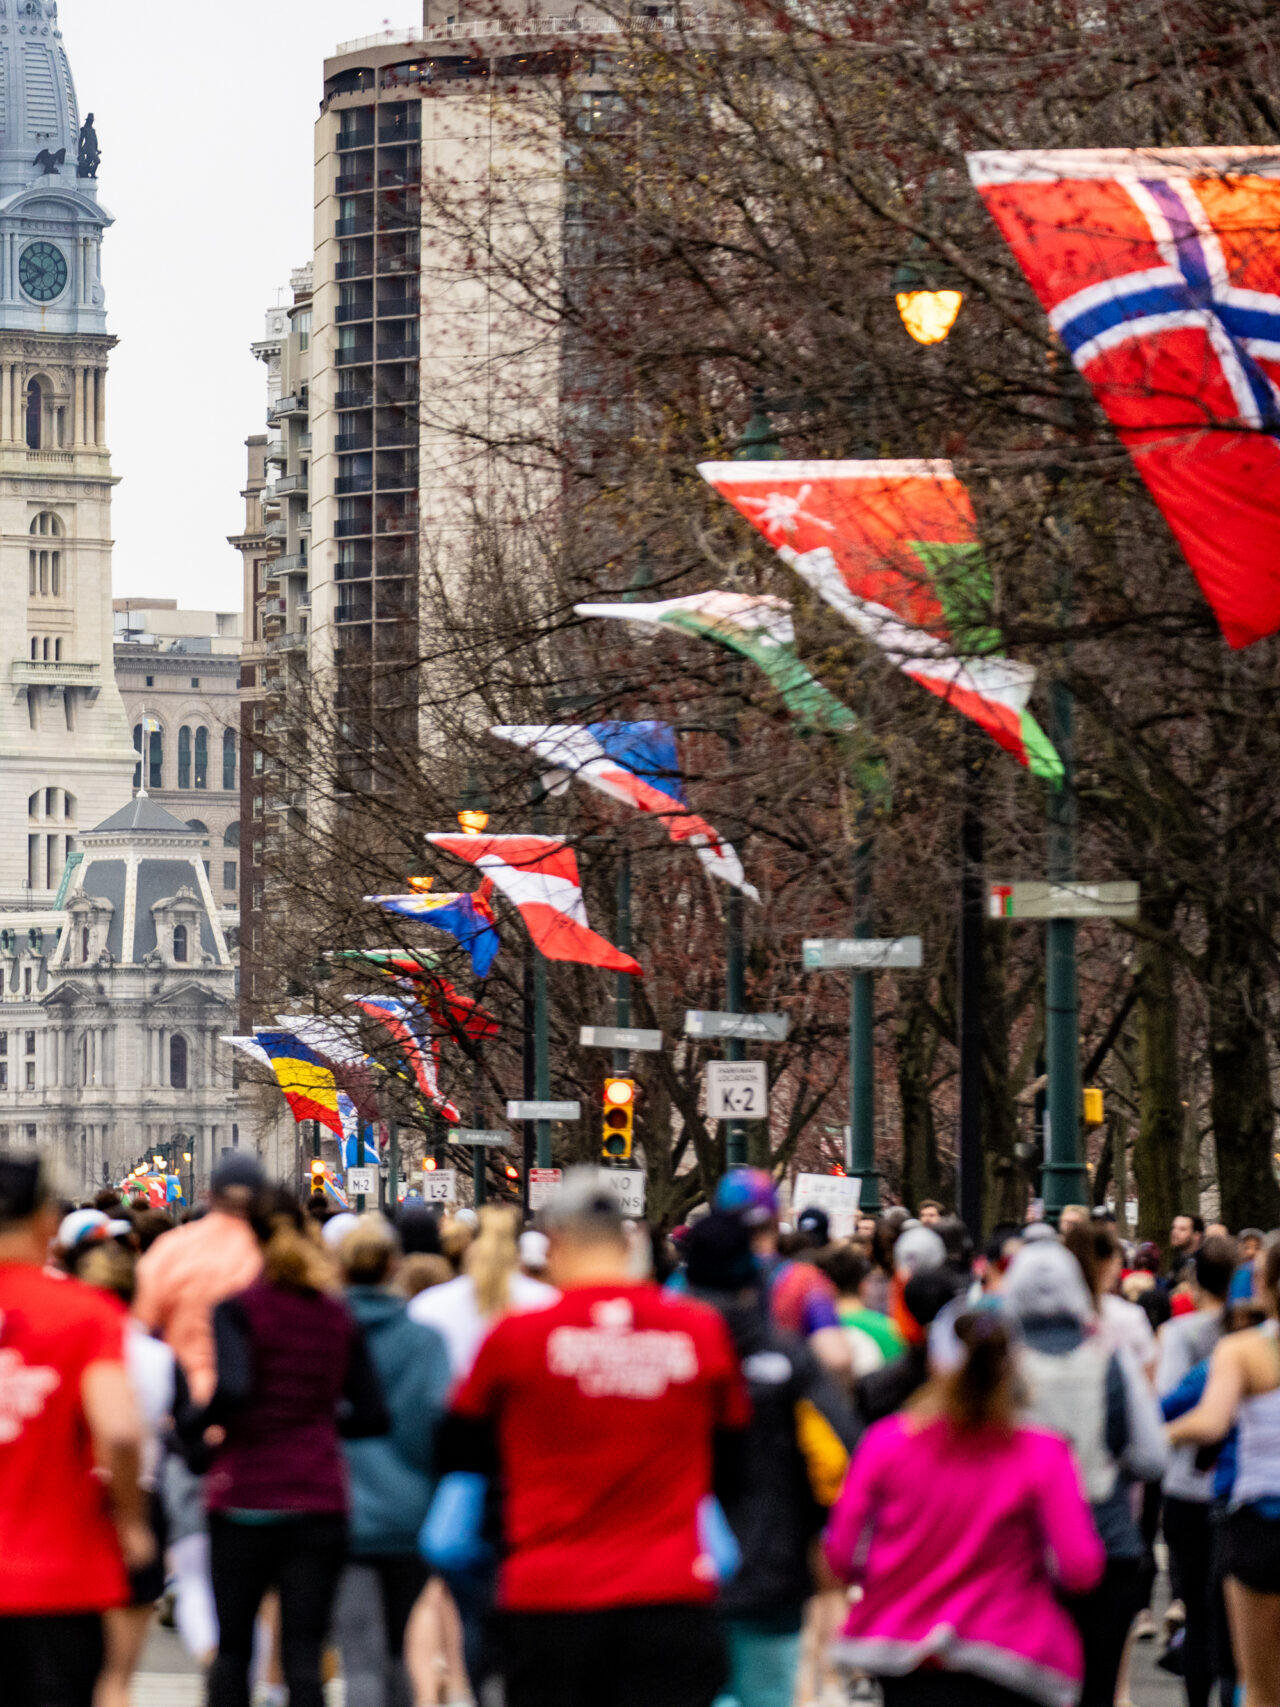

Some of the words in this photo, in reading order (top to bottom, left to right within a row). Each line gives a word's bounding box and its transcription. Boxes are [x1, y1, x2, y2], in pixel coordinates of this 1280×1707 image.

[722, 1087, 755, 1112] K-2
[352, 1179, 370, 1191] M-2
[430, 1183, 449, 1198] L-2
